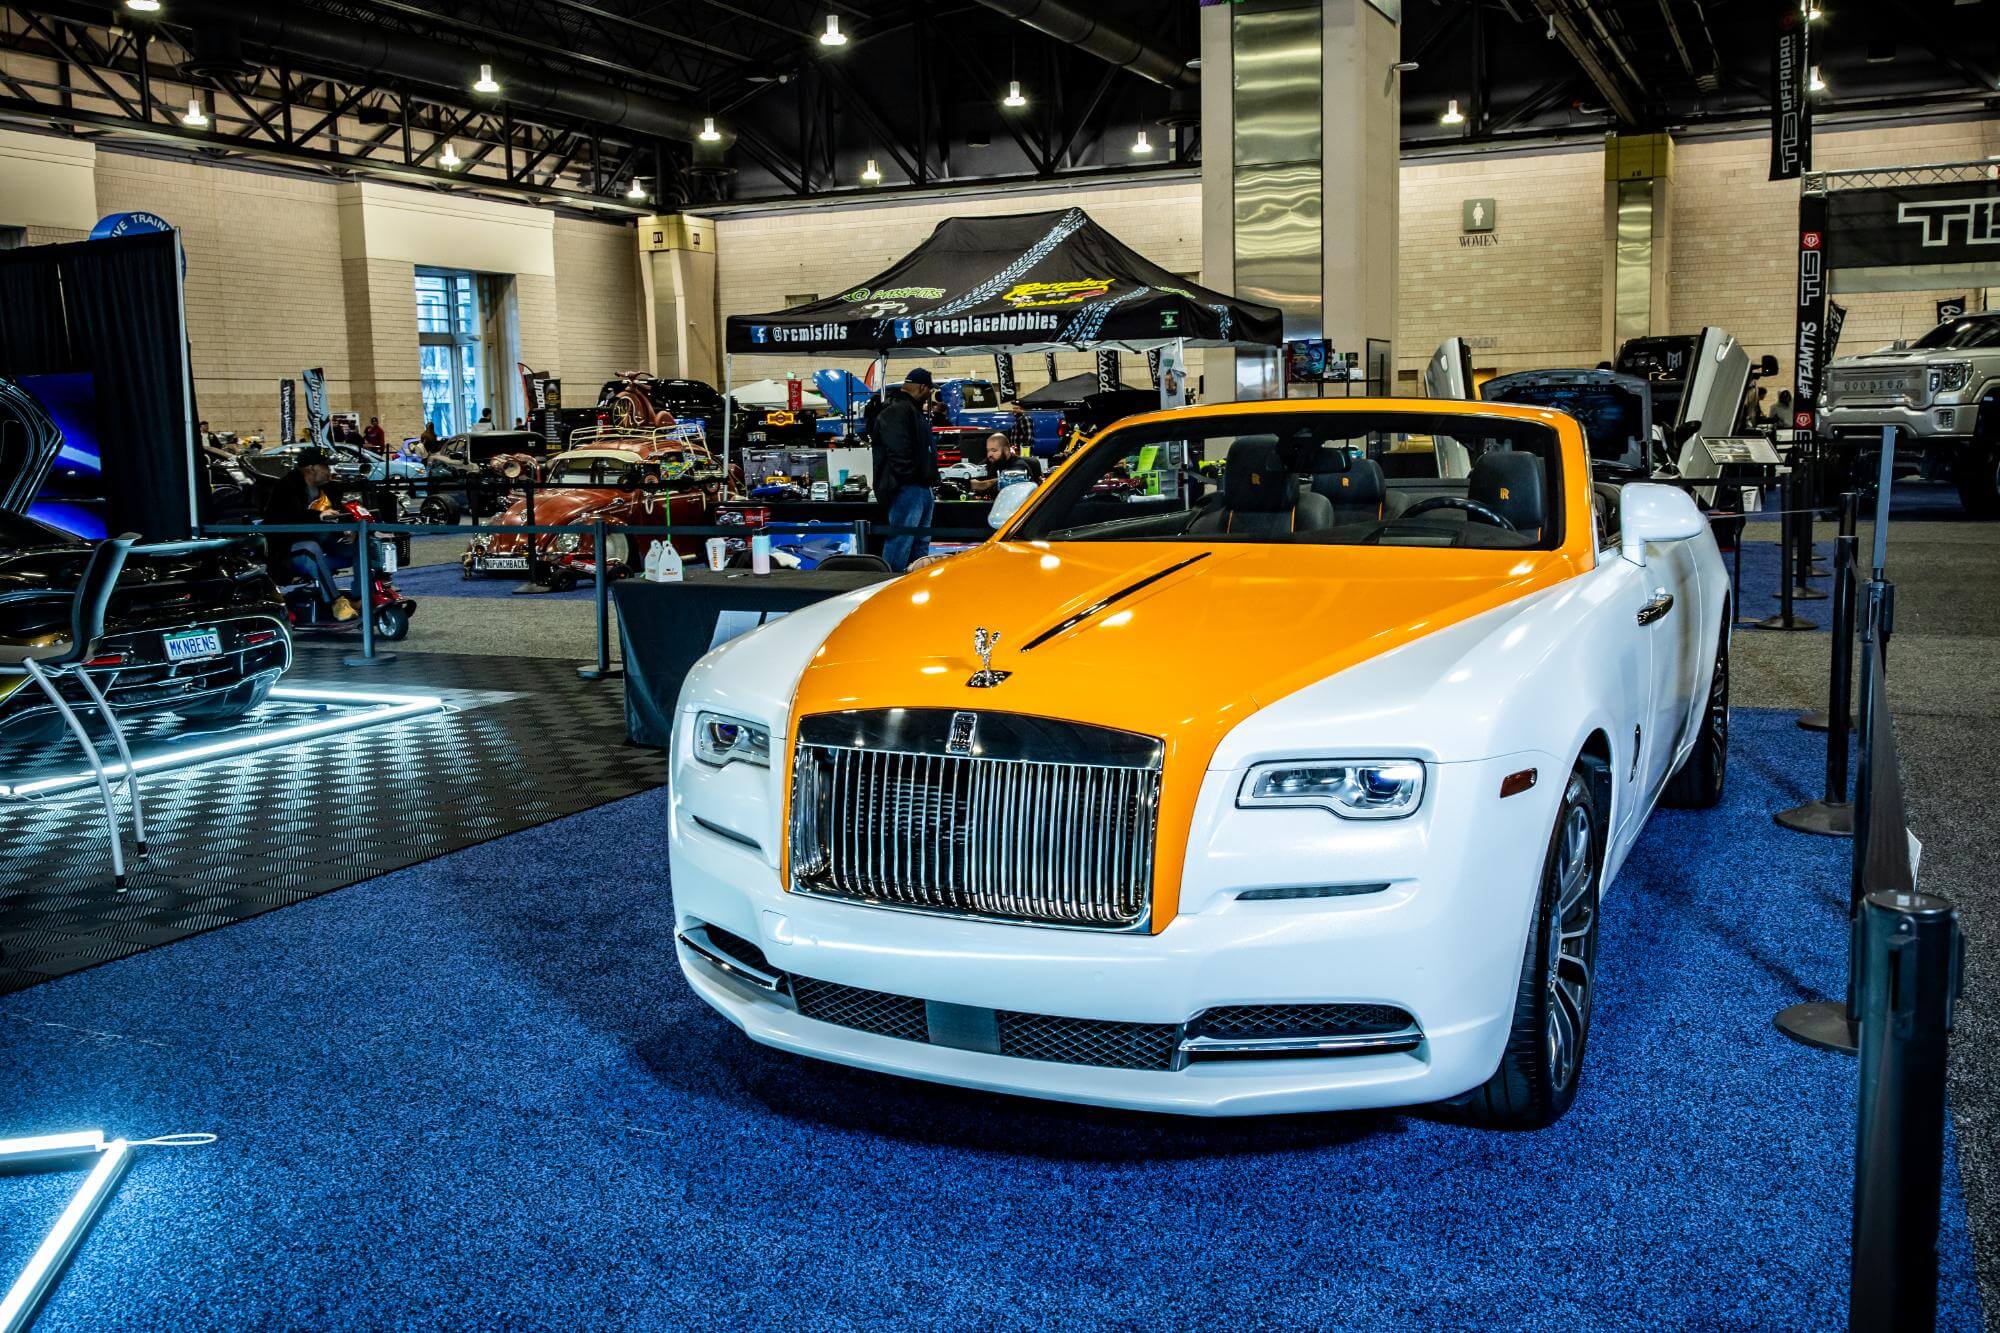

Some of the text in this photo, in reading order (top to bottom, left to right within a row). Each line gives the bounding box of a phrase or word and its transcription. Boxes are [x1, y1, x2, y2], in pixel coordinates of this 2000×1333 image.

[1780, 35, 1798, 174] TIS OFFROAD
[131, 214, 170, 231] TRAIN
[1898, 197, 2000, 247] TI
[1459, 234, 1498, 247] WOMEN
[1801, 251, 1820, 306] TIS
[772, 323, 848, 342] @rcmisfits
[914, 312, 1058, 336] @raceplacehobbies
[1798, 321, 1818, 399] #TEAMTIS
[169, 636, 217, 656] MKNBENS
